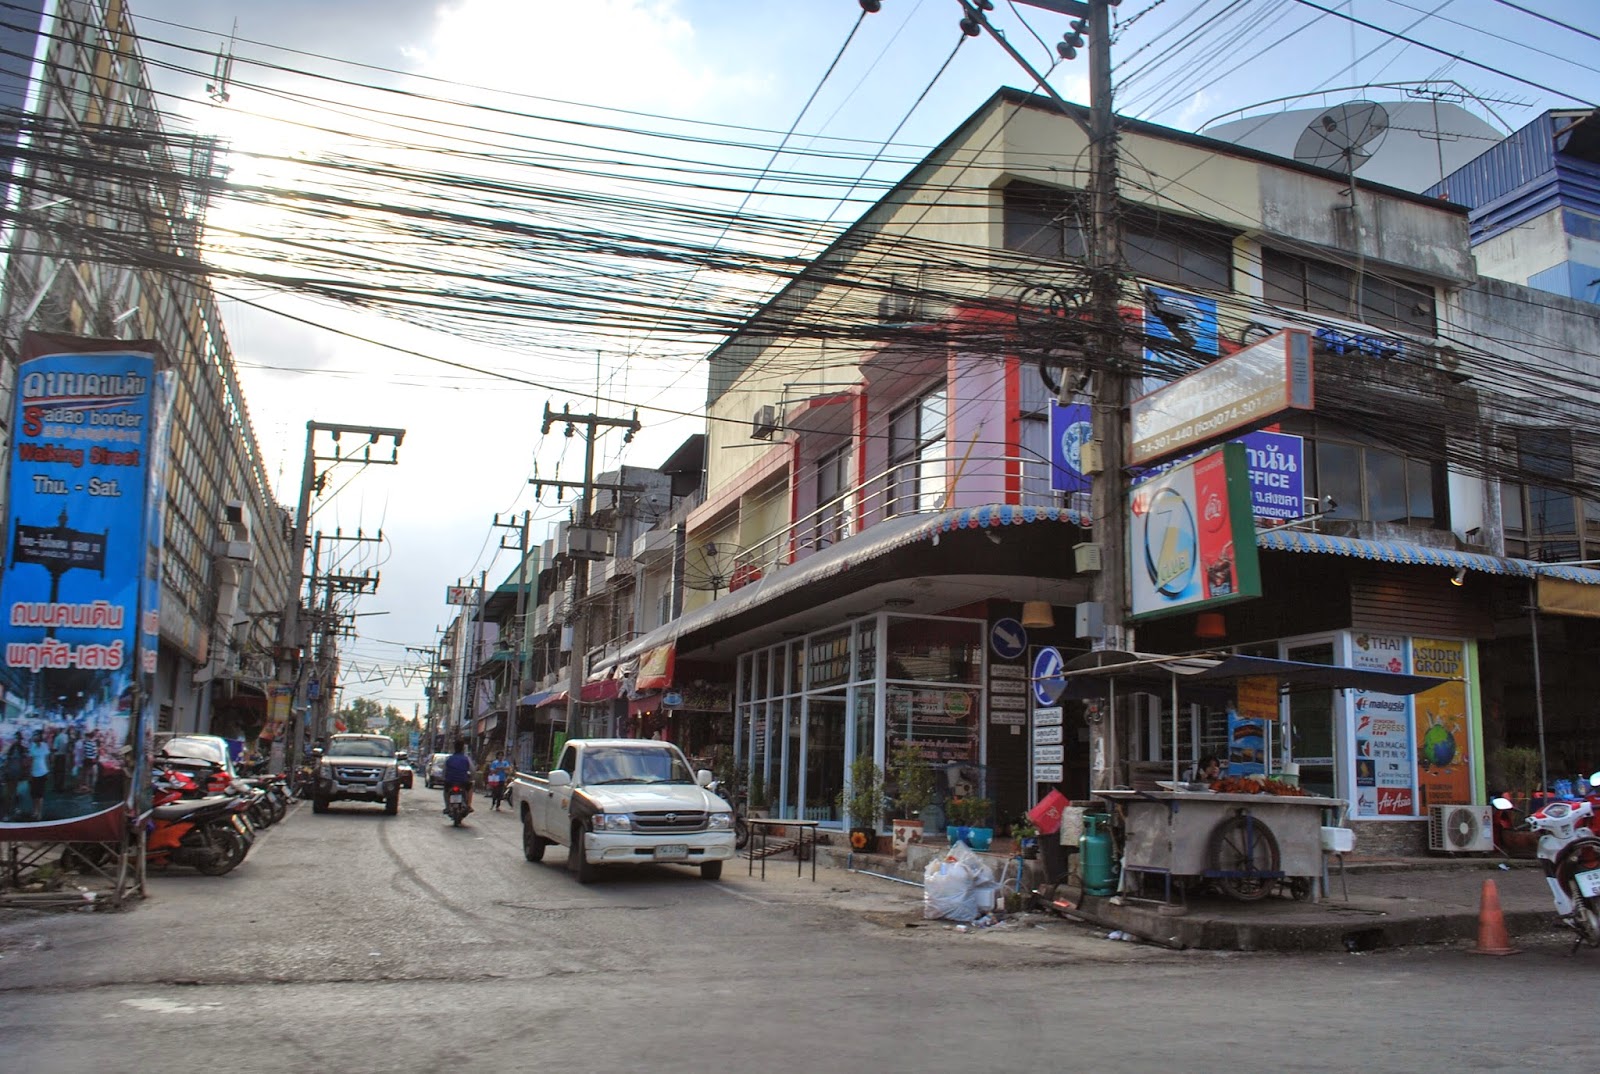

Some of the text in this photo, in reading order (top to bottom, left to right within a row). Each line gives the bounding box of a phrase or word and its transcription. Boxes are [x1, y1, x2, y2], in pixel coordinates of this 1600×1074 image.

[23, 406, 85, 436] Sadao
[90, 410, 143, 427] border
[18, 442, 140, 468] Walking Street
[32, 475, 69, 495] Thu.
[88, 477, 121, 496] Sat.
[1248, 470, 1290, 488] FFICE
[1255, 491, 1298, 507] จ.สงขลา
[11, 601, 124, 629] ถนนคนเดิน
[1371, 637, 1401, 650] THAI
[7, 636, 124, 674] พฤหัส-เสาร์
[1416, 660, 1458, 674] GROUP
[1369, 700, 1405, 711] malaysia
[1372, 723, 1405, 732] EXPRESS
